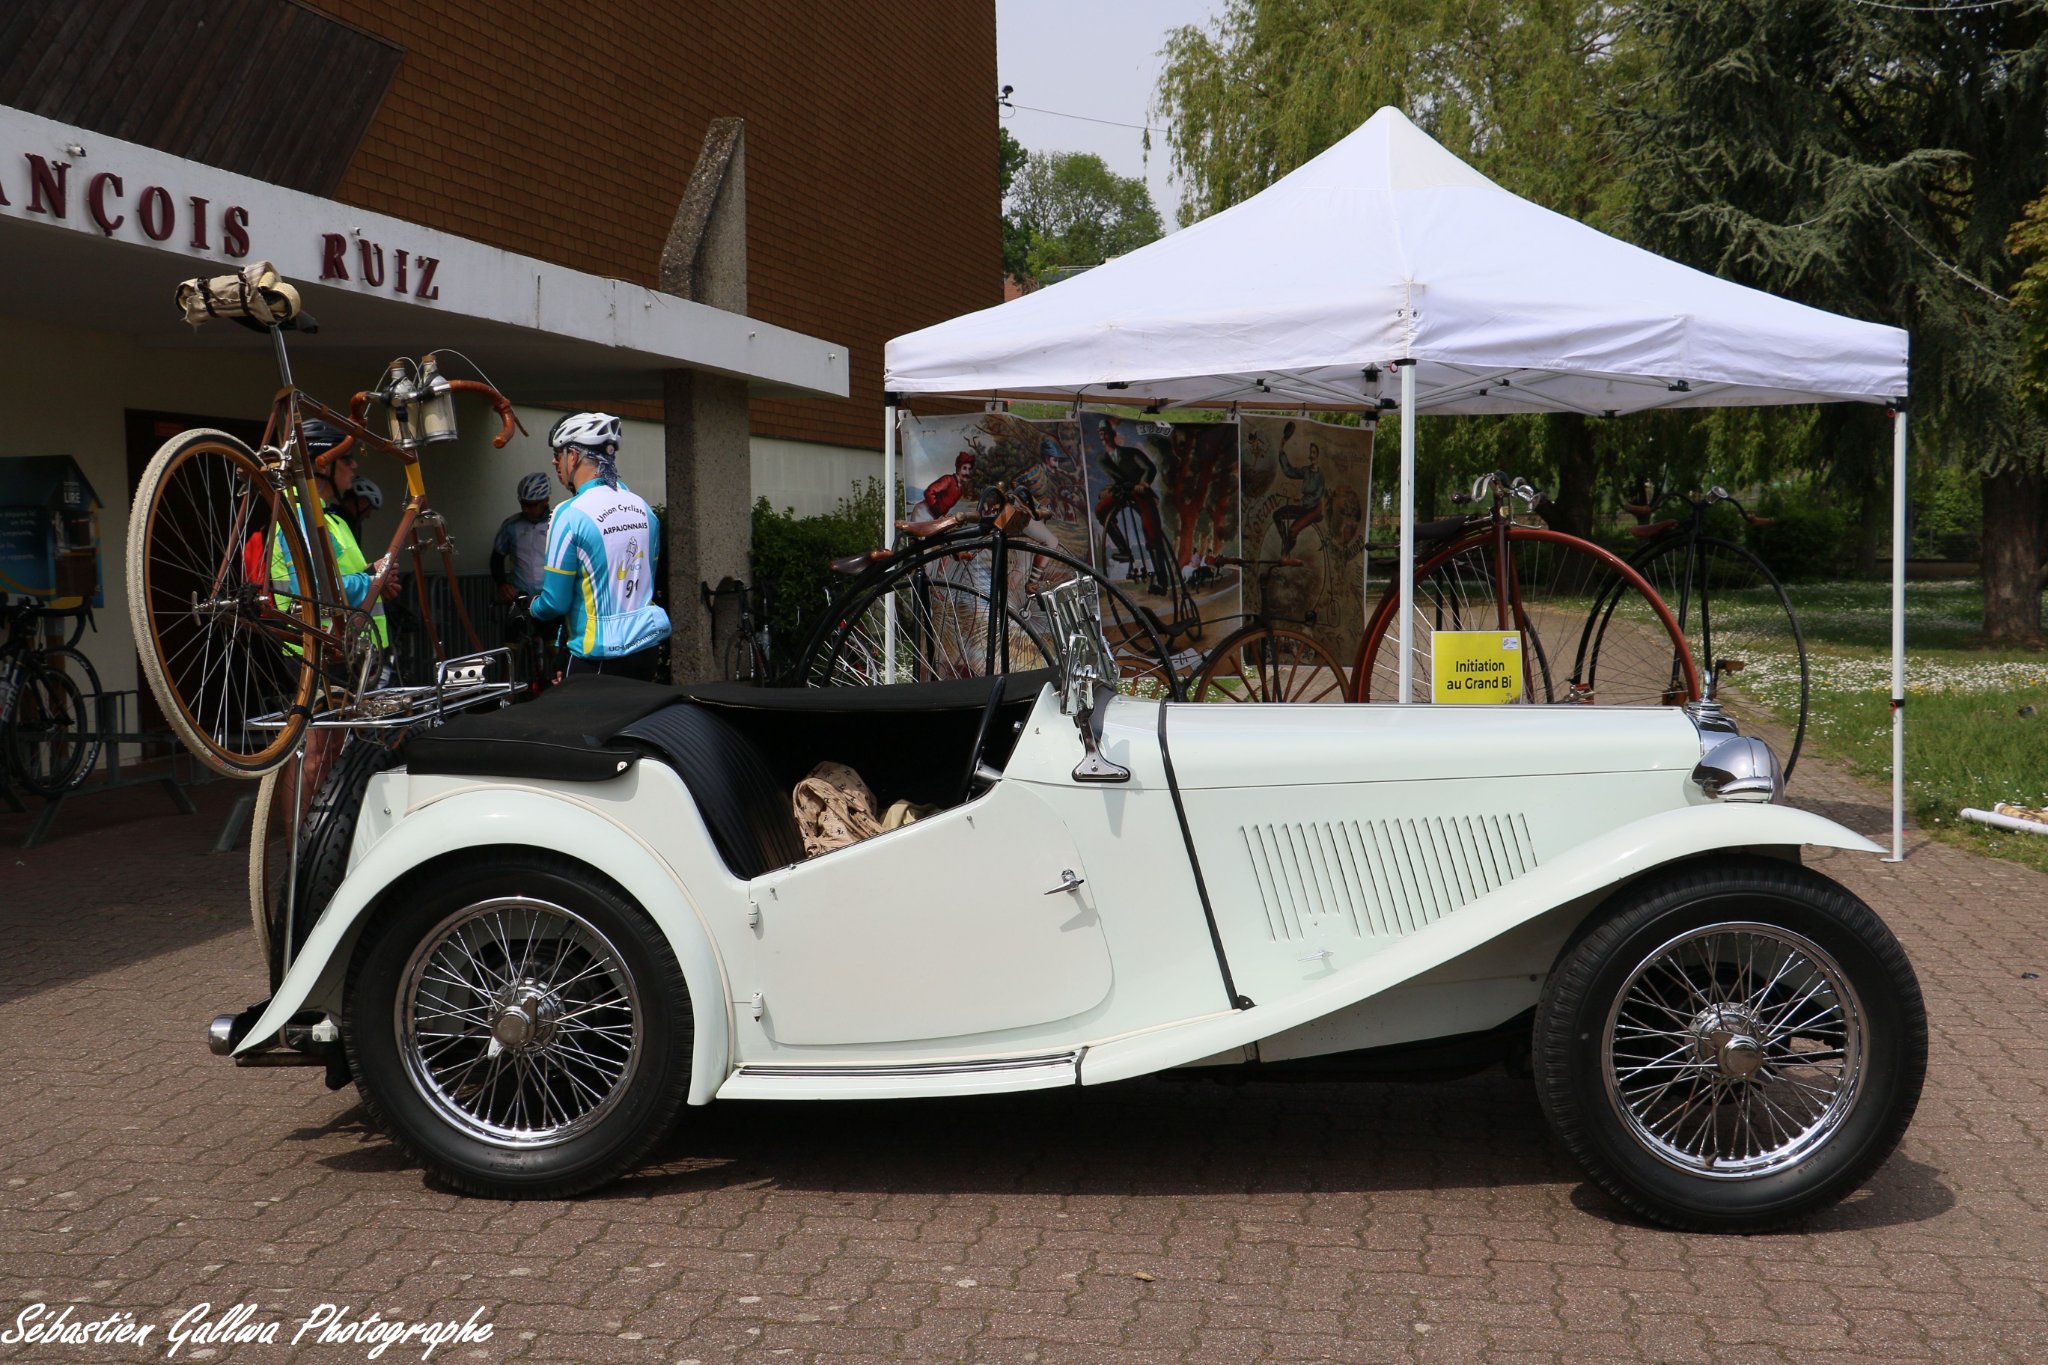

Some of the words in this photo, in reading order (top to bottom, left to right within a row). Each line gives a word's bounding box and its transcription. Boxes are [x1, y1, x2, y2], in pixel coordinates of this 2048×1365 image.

[319, 233, 440, 301] RUIZ
[596, 506, 617, 524] Union
[617, 504, 647, 518] Cycliste
[603, 522, 648, 536] ARPAJONNAIS
[626, 579, 640, 599] 91
[1455, 659, 1505, 672] Initiation
[1447, 679, 1462, 690] au
[1465, 676, 1499, 689] Grand
[1501, 675, 1512, 688] Bi
